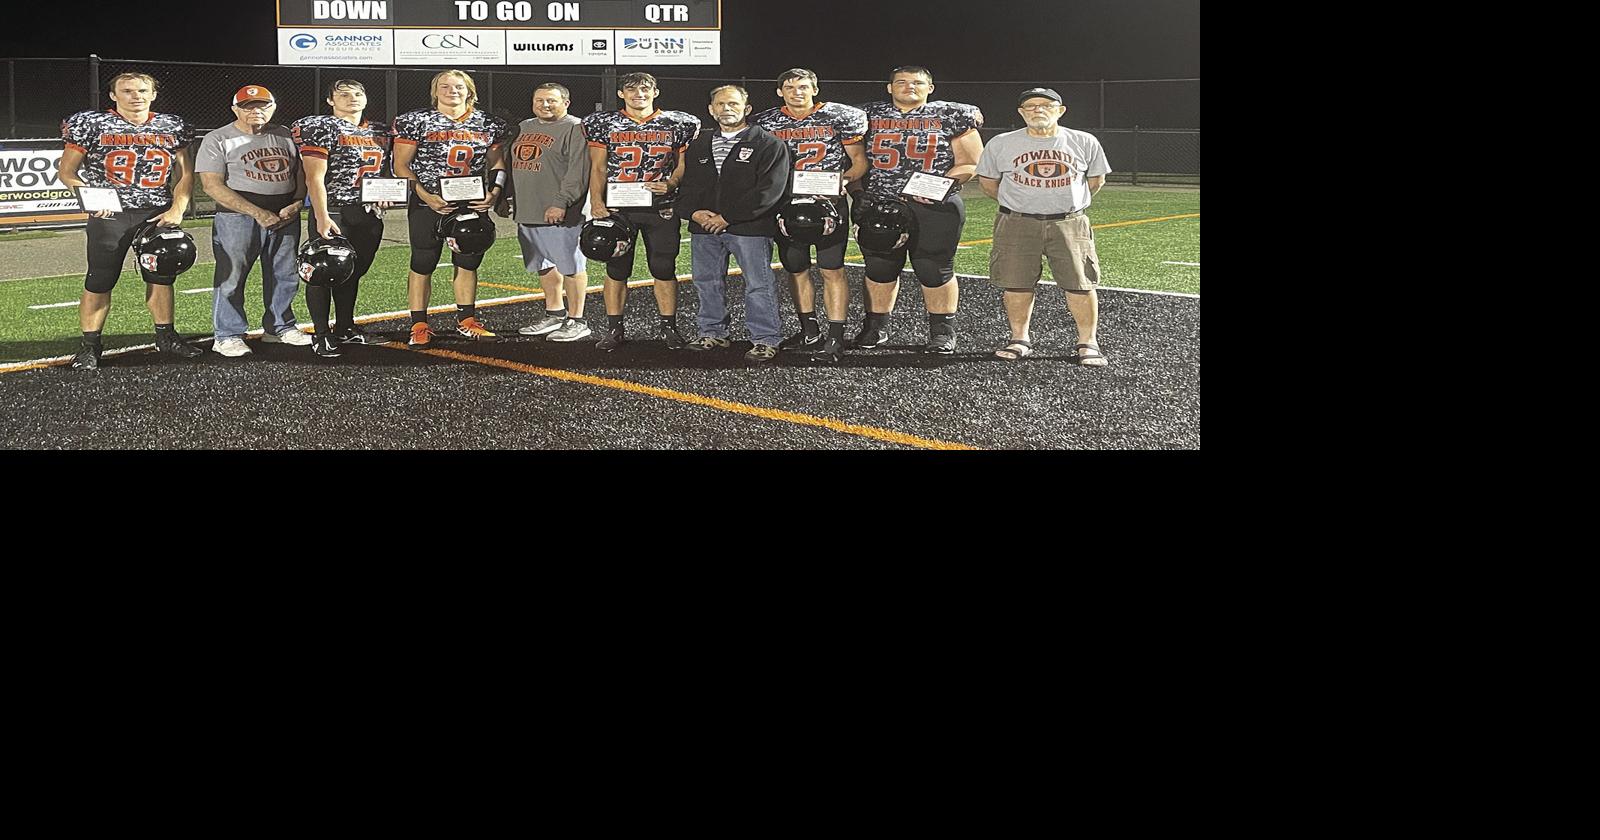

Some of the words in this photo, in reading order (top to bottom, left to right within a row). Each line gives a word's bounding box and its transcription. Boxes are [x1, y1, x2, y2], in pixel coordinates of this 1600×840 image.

[313, 0, 387, 19] DOWN
[454, 0, 488, 20] TO
[496, 1, 531, 21] GO
[547, 2, 579, 21] ON
[645, 4, 689, 23] QTR
[422, 33, 479, 48] C&N
[513, 43, 574, 52] WILLIAMS
[624, 37, 684, 50] DUNN
[240, 146, 289, 165] TOWAND
[446, 145, 475, 176] 9
[795, 142, 827, 171] 2
[872, 133, 938, 171] 54
[103, 148, 172, 187] 83
[244, 169, 274, 182] BLACK
[352, 150, 384, 188] 2
[1013, 172, 1041, 188] BLACK
